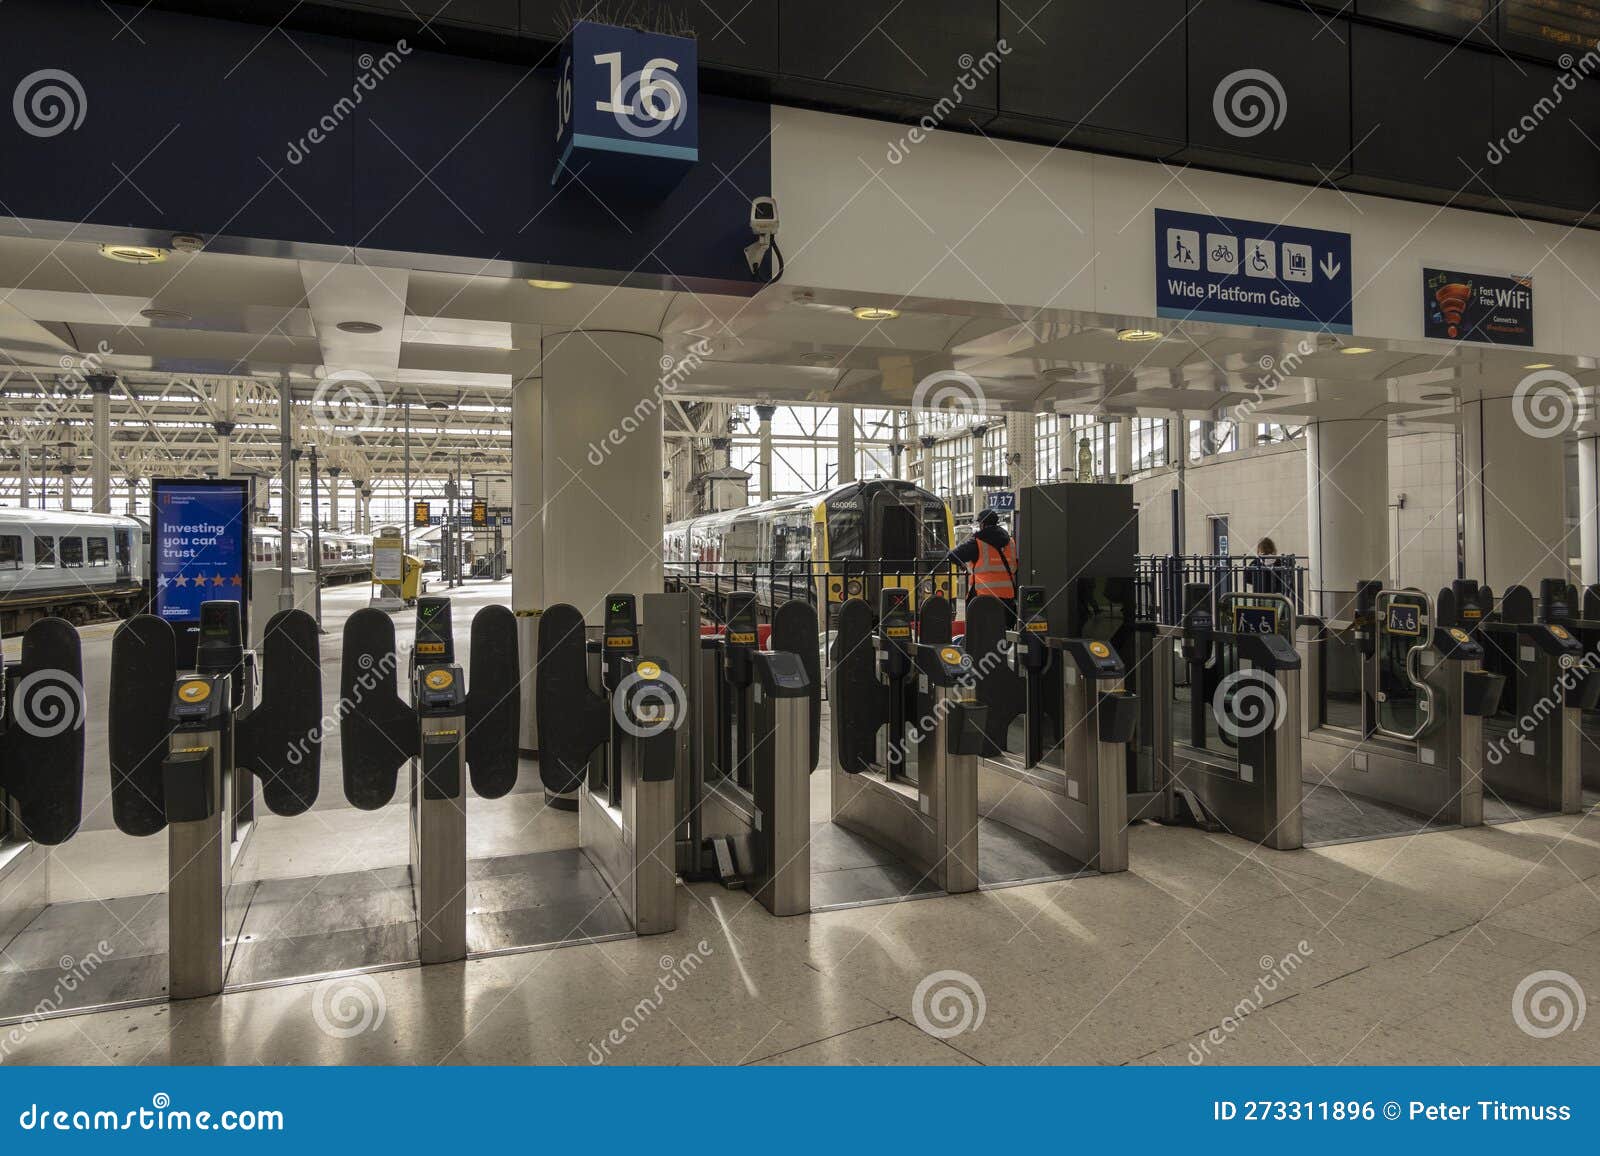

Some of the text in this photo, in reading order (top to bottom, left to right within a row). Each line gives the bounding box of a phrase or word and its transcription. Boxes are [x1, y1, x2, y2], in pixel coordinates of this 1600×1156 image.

[594, 51, 682, 121] 16
[1168, 279, 1301, 308] Wide Platform Gate
[1480, 286, 1530, 310] Fast WiFi
[163, 522, 225, 536] Investing
[163, 537, 217, 548] you can
